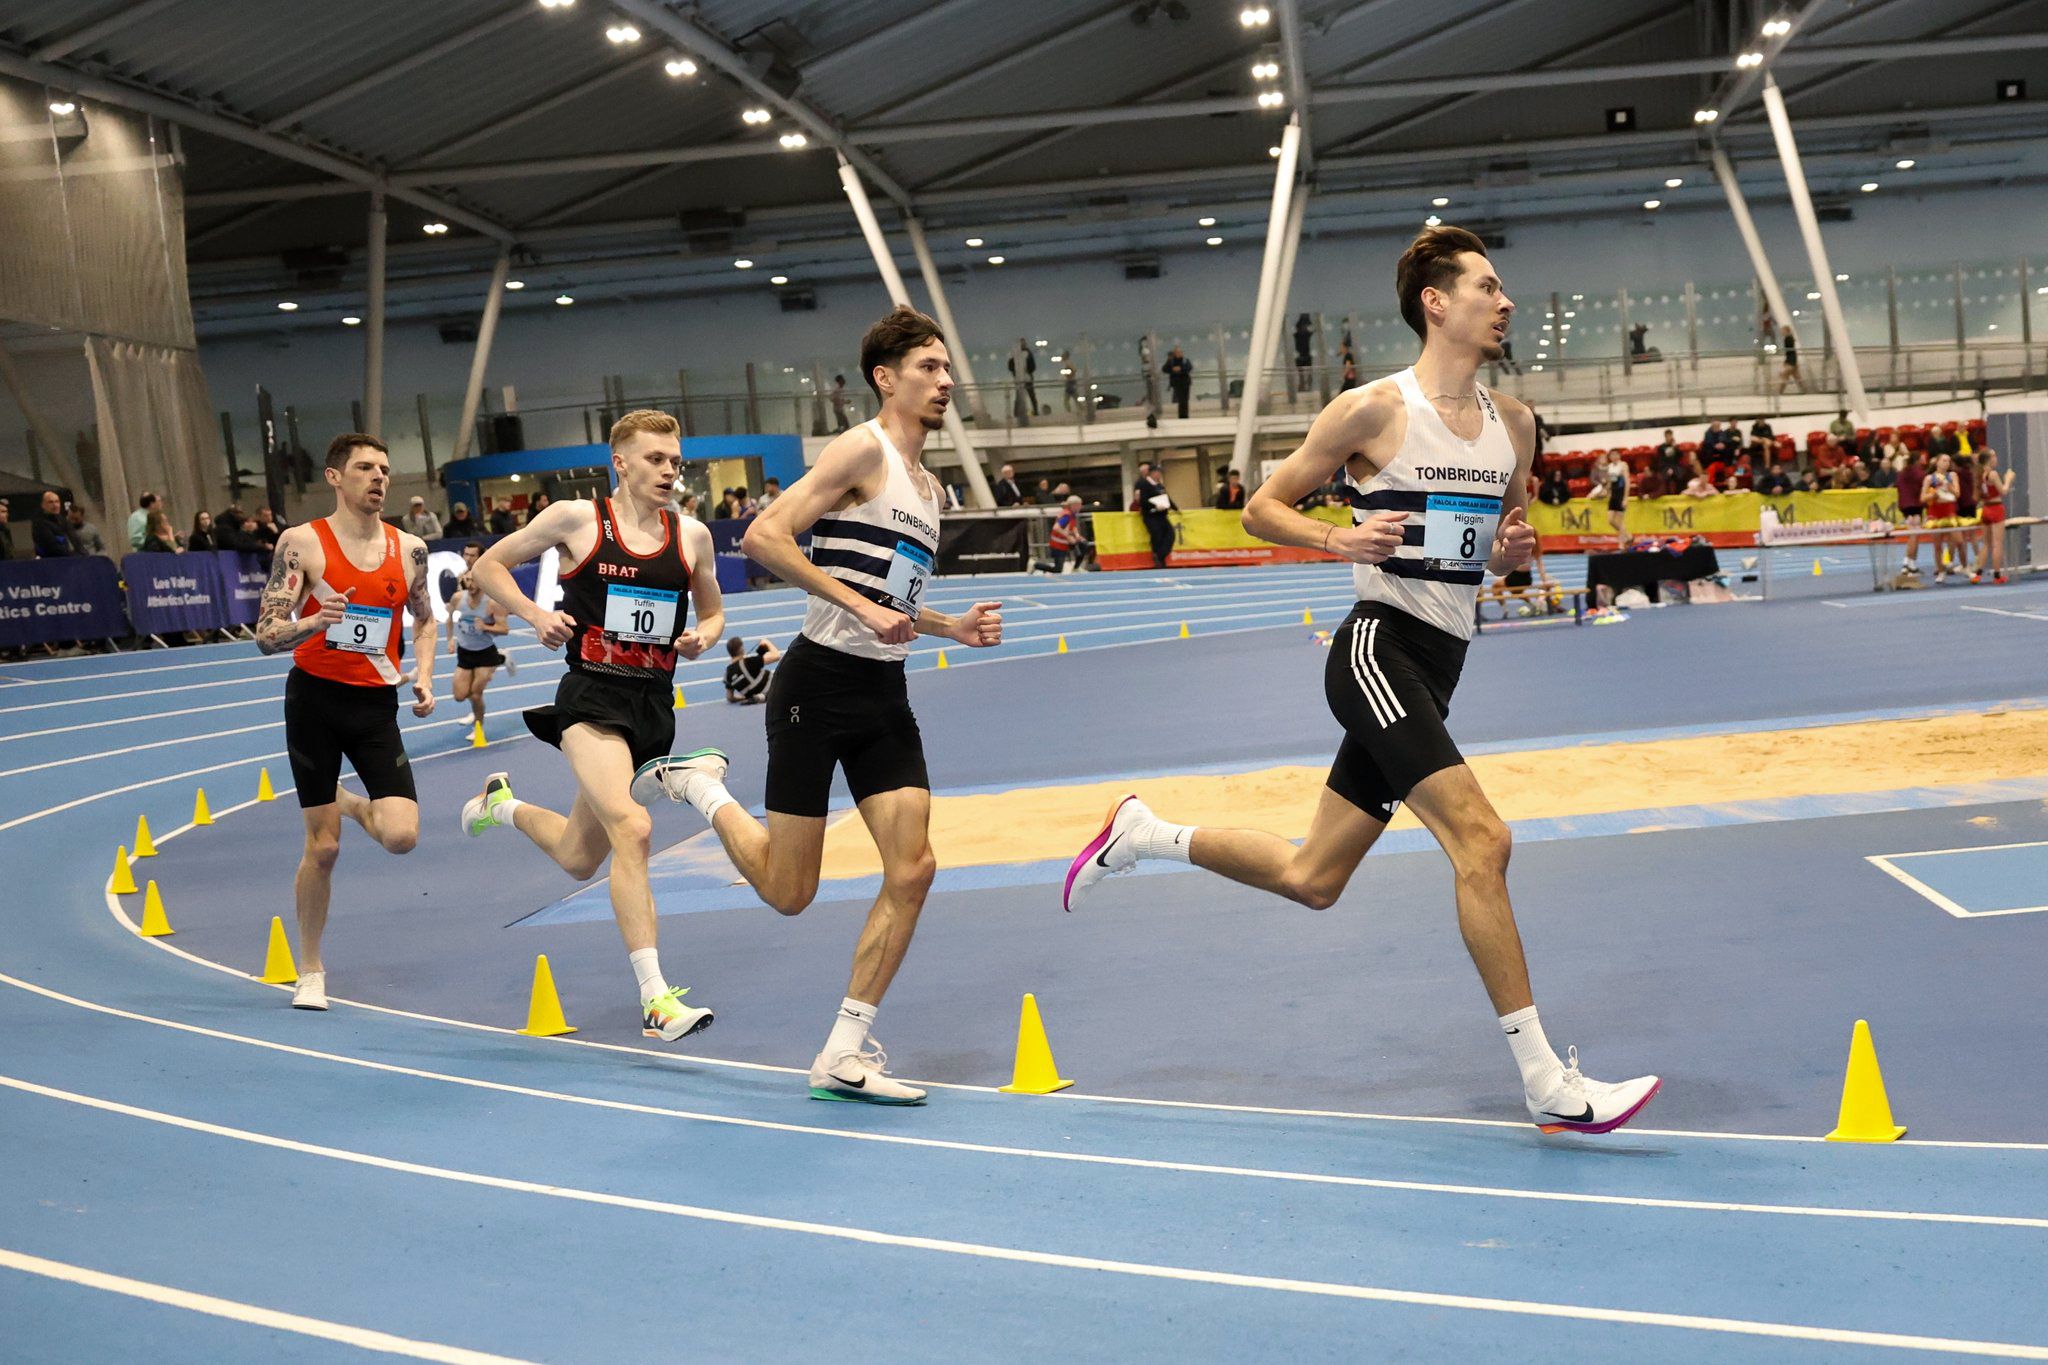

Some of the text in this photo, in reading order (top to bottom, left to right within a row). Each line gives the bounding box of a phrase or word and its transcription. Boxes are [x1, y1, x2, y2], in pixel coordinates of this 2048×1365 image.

[1415, 466, 1498, 484] TONBRIDGE
[892, 507, 937, 543] TONBRIDGE
[1454, 513, 1484, 525] Higgins
[1459, 527, 1477, 559] 8
[598, 562, 639, 578] BRAT
[7, 584, 61, 600] Valley
[906, 576, 923, 605] 12
[35, 601, 92, 616] Centre
[633, 599, 655, 608] Tuffin
[344, 614, 379, 624] Wakefield
[631, 609, 655, 634] 10
[352, 623, 367, 645] 9
